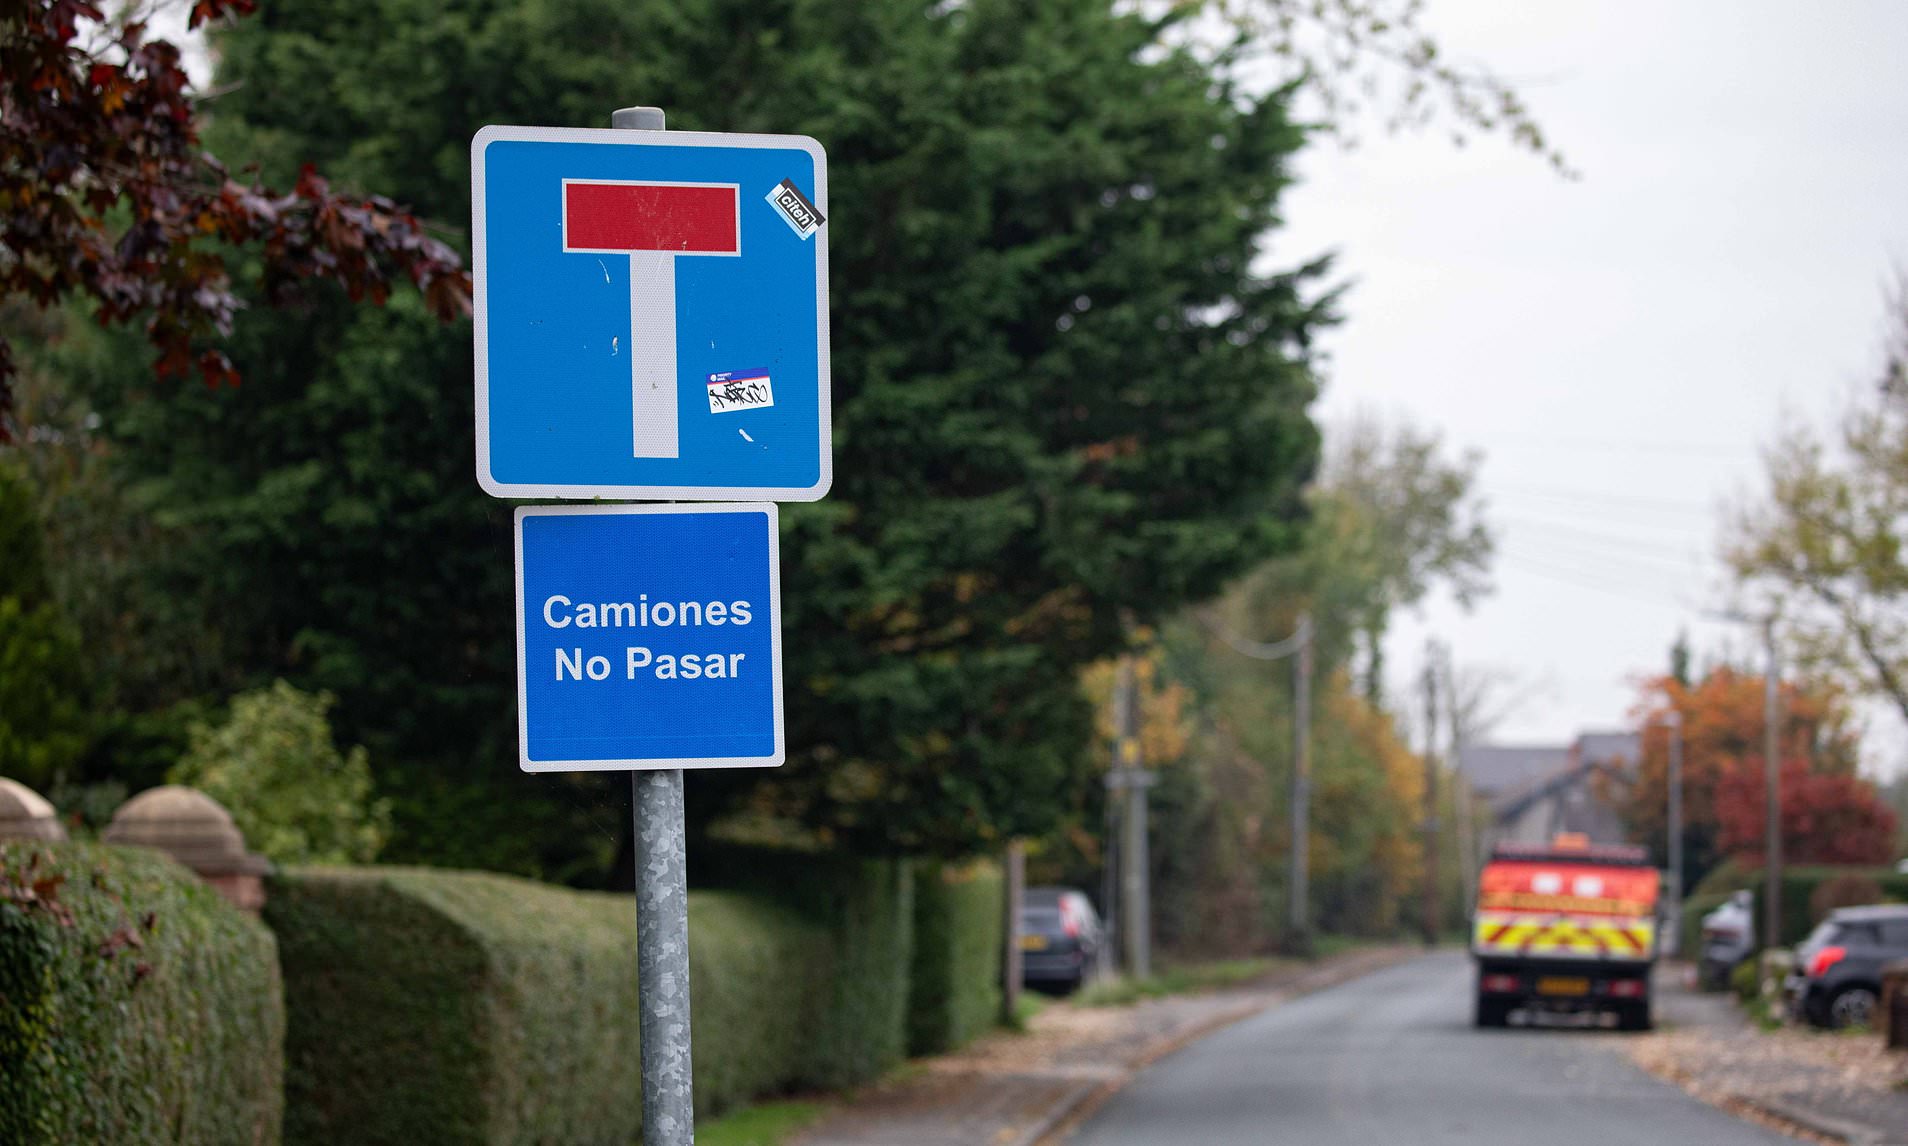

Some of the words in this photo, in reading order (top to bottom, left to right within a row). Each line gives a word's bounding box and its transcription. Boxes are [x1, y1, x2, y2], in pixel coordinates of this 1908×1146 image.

[781, 195, 811, 226] citeh
[543, 593, 753, 629] Camiones
[555, 647, 611, 681] No
[626, 646, 746, 680] Pasar
